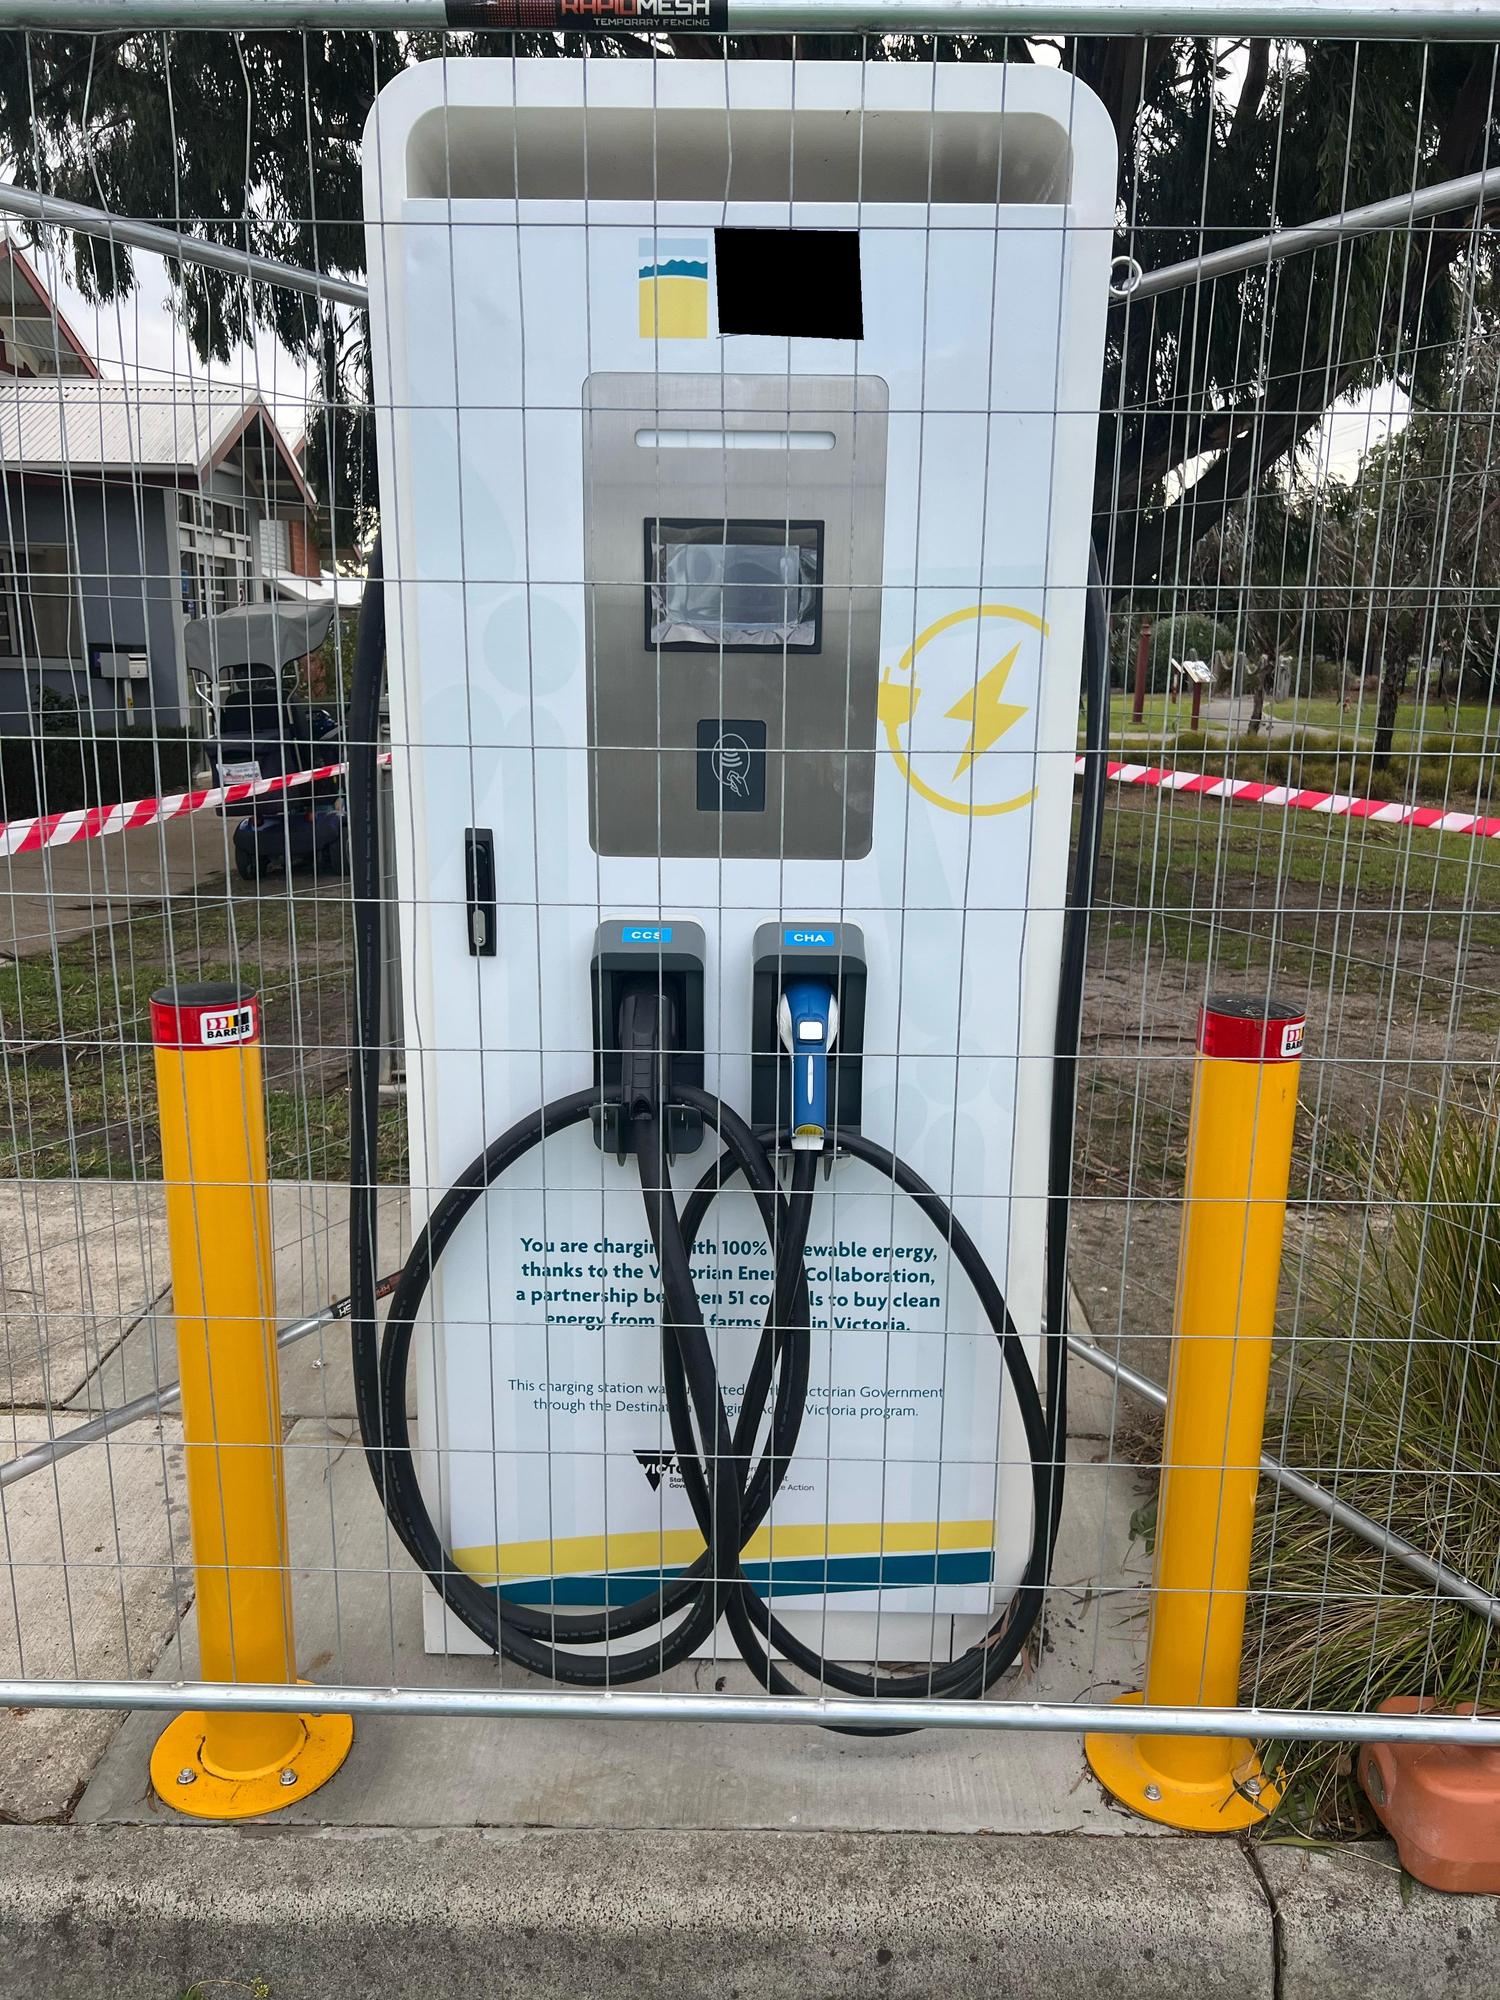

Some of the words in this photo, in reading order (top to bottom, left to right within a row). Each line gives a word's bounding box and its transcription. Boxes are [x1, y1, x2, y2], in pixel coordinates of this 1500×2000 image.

[594, 18, 659, 26] TEMPORARY
[663, 18, 710, 26] FENCING
[631, 931, 662, 939] CCS
[793, 933, 825, 942] CHA
[520, 1238, 555, 1252] You
[560, 1241, 588, 1253] are
[594, 1238, 656, 1258] chargin
[692, 1239, 717, 1254] ith
[722, 1240, 767, 1255] 100%
[804, 1241, 867, 1257] ewable
[872, 1246, 938, 1262] energy,
[521, 1261, 583, 1277] thanks
[588, 1265, 608, 1278] to
[613, 1262, 644, 1278] the
[649, 1265, 733, 1280] Vorian
[805, 1266, 935, 1285] Collaboration,
[516, 1290, 525, 1301] a
[531, 1288, 638, 1307] partnership
[728, 1291, 744, 1304] 51
[828, 1295, 848, 1307] to
[854, 1291, 888, 1311] buy
[893, 1292, 940, 1307] clean
[611, 1312, 655, 1327] from
[709, 1313, 761, 1328] farms
[812, 1316, 828, 1329] in
[834, 1317, 911, 1331] Victoria.
[508, 1379, 535, 1391] This
[539, 1381, 593, 1395] charging
[598, 1382, 643, 1394] station
[647, 1385, 666, 1394] wa
[860, 1385, 944, 1398] Government
[533, 1398, 585, 1414] through
[590, 1398, 611, 1411] the
[805, 1404, 856, 1415] Victoria
[861, 1406, 918, 1419] program.
[787, 1483, 815, 1491] Action
